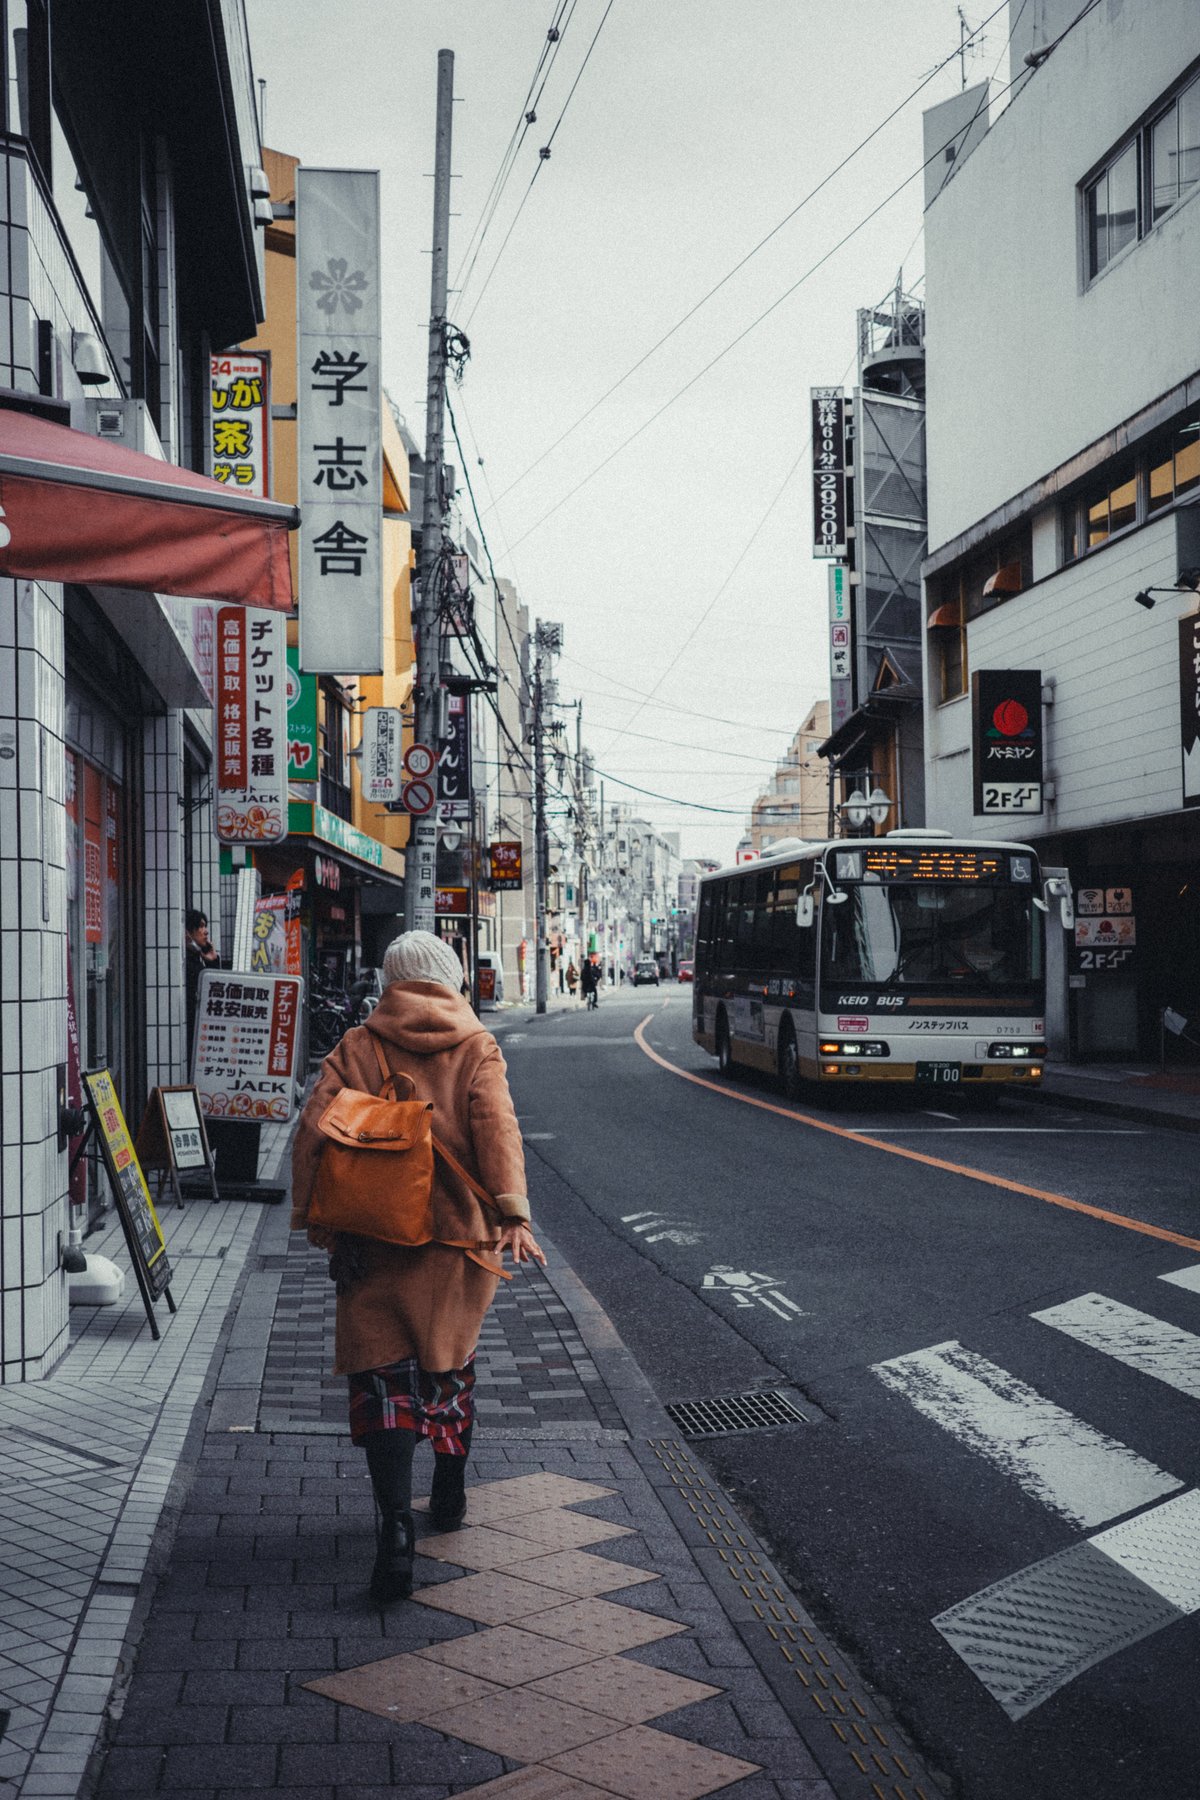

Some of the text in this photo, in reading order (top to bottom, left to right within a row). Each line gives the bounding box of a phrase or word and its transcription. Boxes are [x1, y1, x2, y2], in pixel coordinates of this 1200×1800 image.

[212, 420, 252, 459] 茶
[311, 350, 368, 577] 学志舎
[223, 620, 241, 776] 高価買取・格安販売
[251, 620, 275, 776] チケット各種
[288, 723, 312, 734] ストラン
[410, 754, 429, 769] 30
[987, 746, 1036, 759] バーミヤン
[237, 795, 280, 803] JACK
[985, 788, 1012, 808] 2F
[1080, 951, 1106, 969] 2F
[208, 981, 269, 1001] 高価買取
[206, 1000, 268, 1020] 格安販売
[838, 996, 905, 1006] KEIO BUS
[271, 985, 293, 1072] チケット各種
[908, 1020, 969, 1031] ノンステップバス
[203, 1066, 247, 1077] チケット
[227, 1080, 287, 1094] JACK
